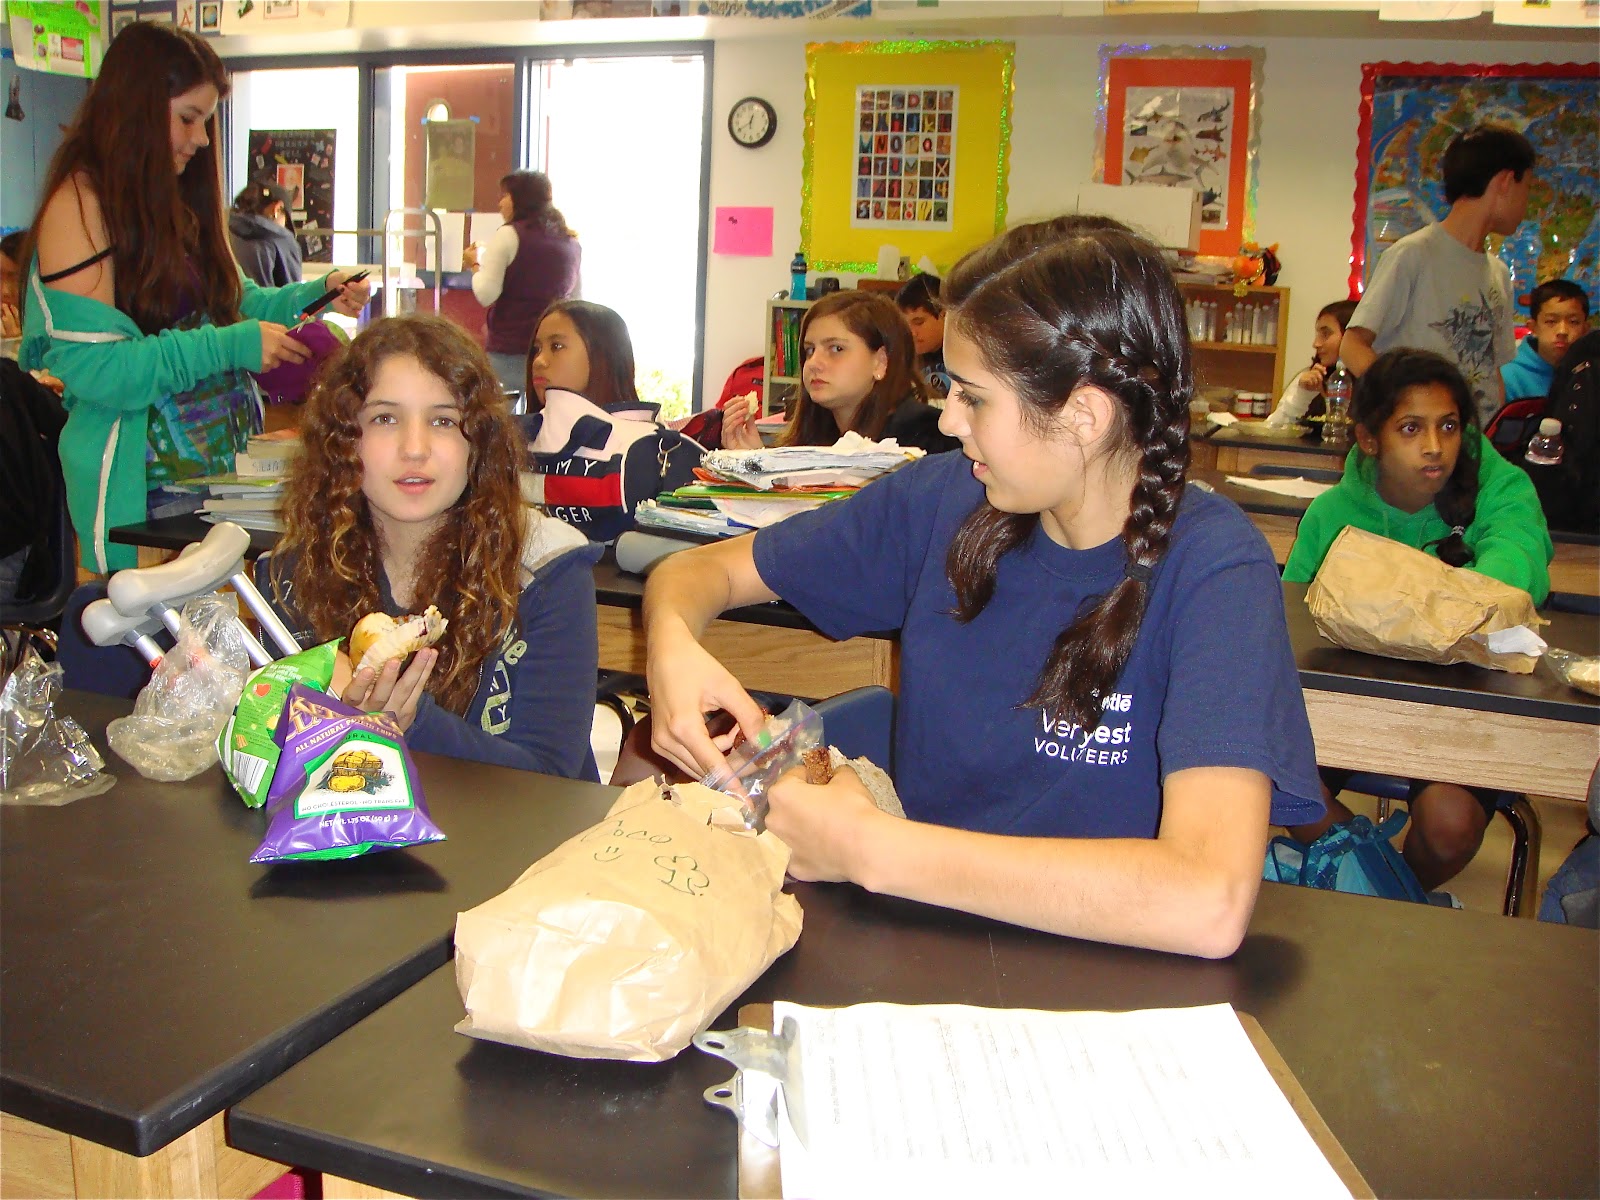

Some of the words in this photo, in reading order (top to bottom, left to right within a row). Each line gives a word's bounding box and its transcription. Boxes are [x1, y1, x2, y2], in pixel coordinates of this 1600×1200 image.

[295, 743, 310, 754] ALL
[309, 723, 346, 745] NATURAL
[1094, 721, 1132, 745] est
[1034, 737, 1129, 765] VOLEERS
[319, 818, 334, 829] NET
